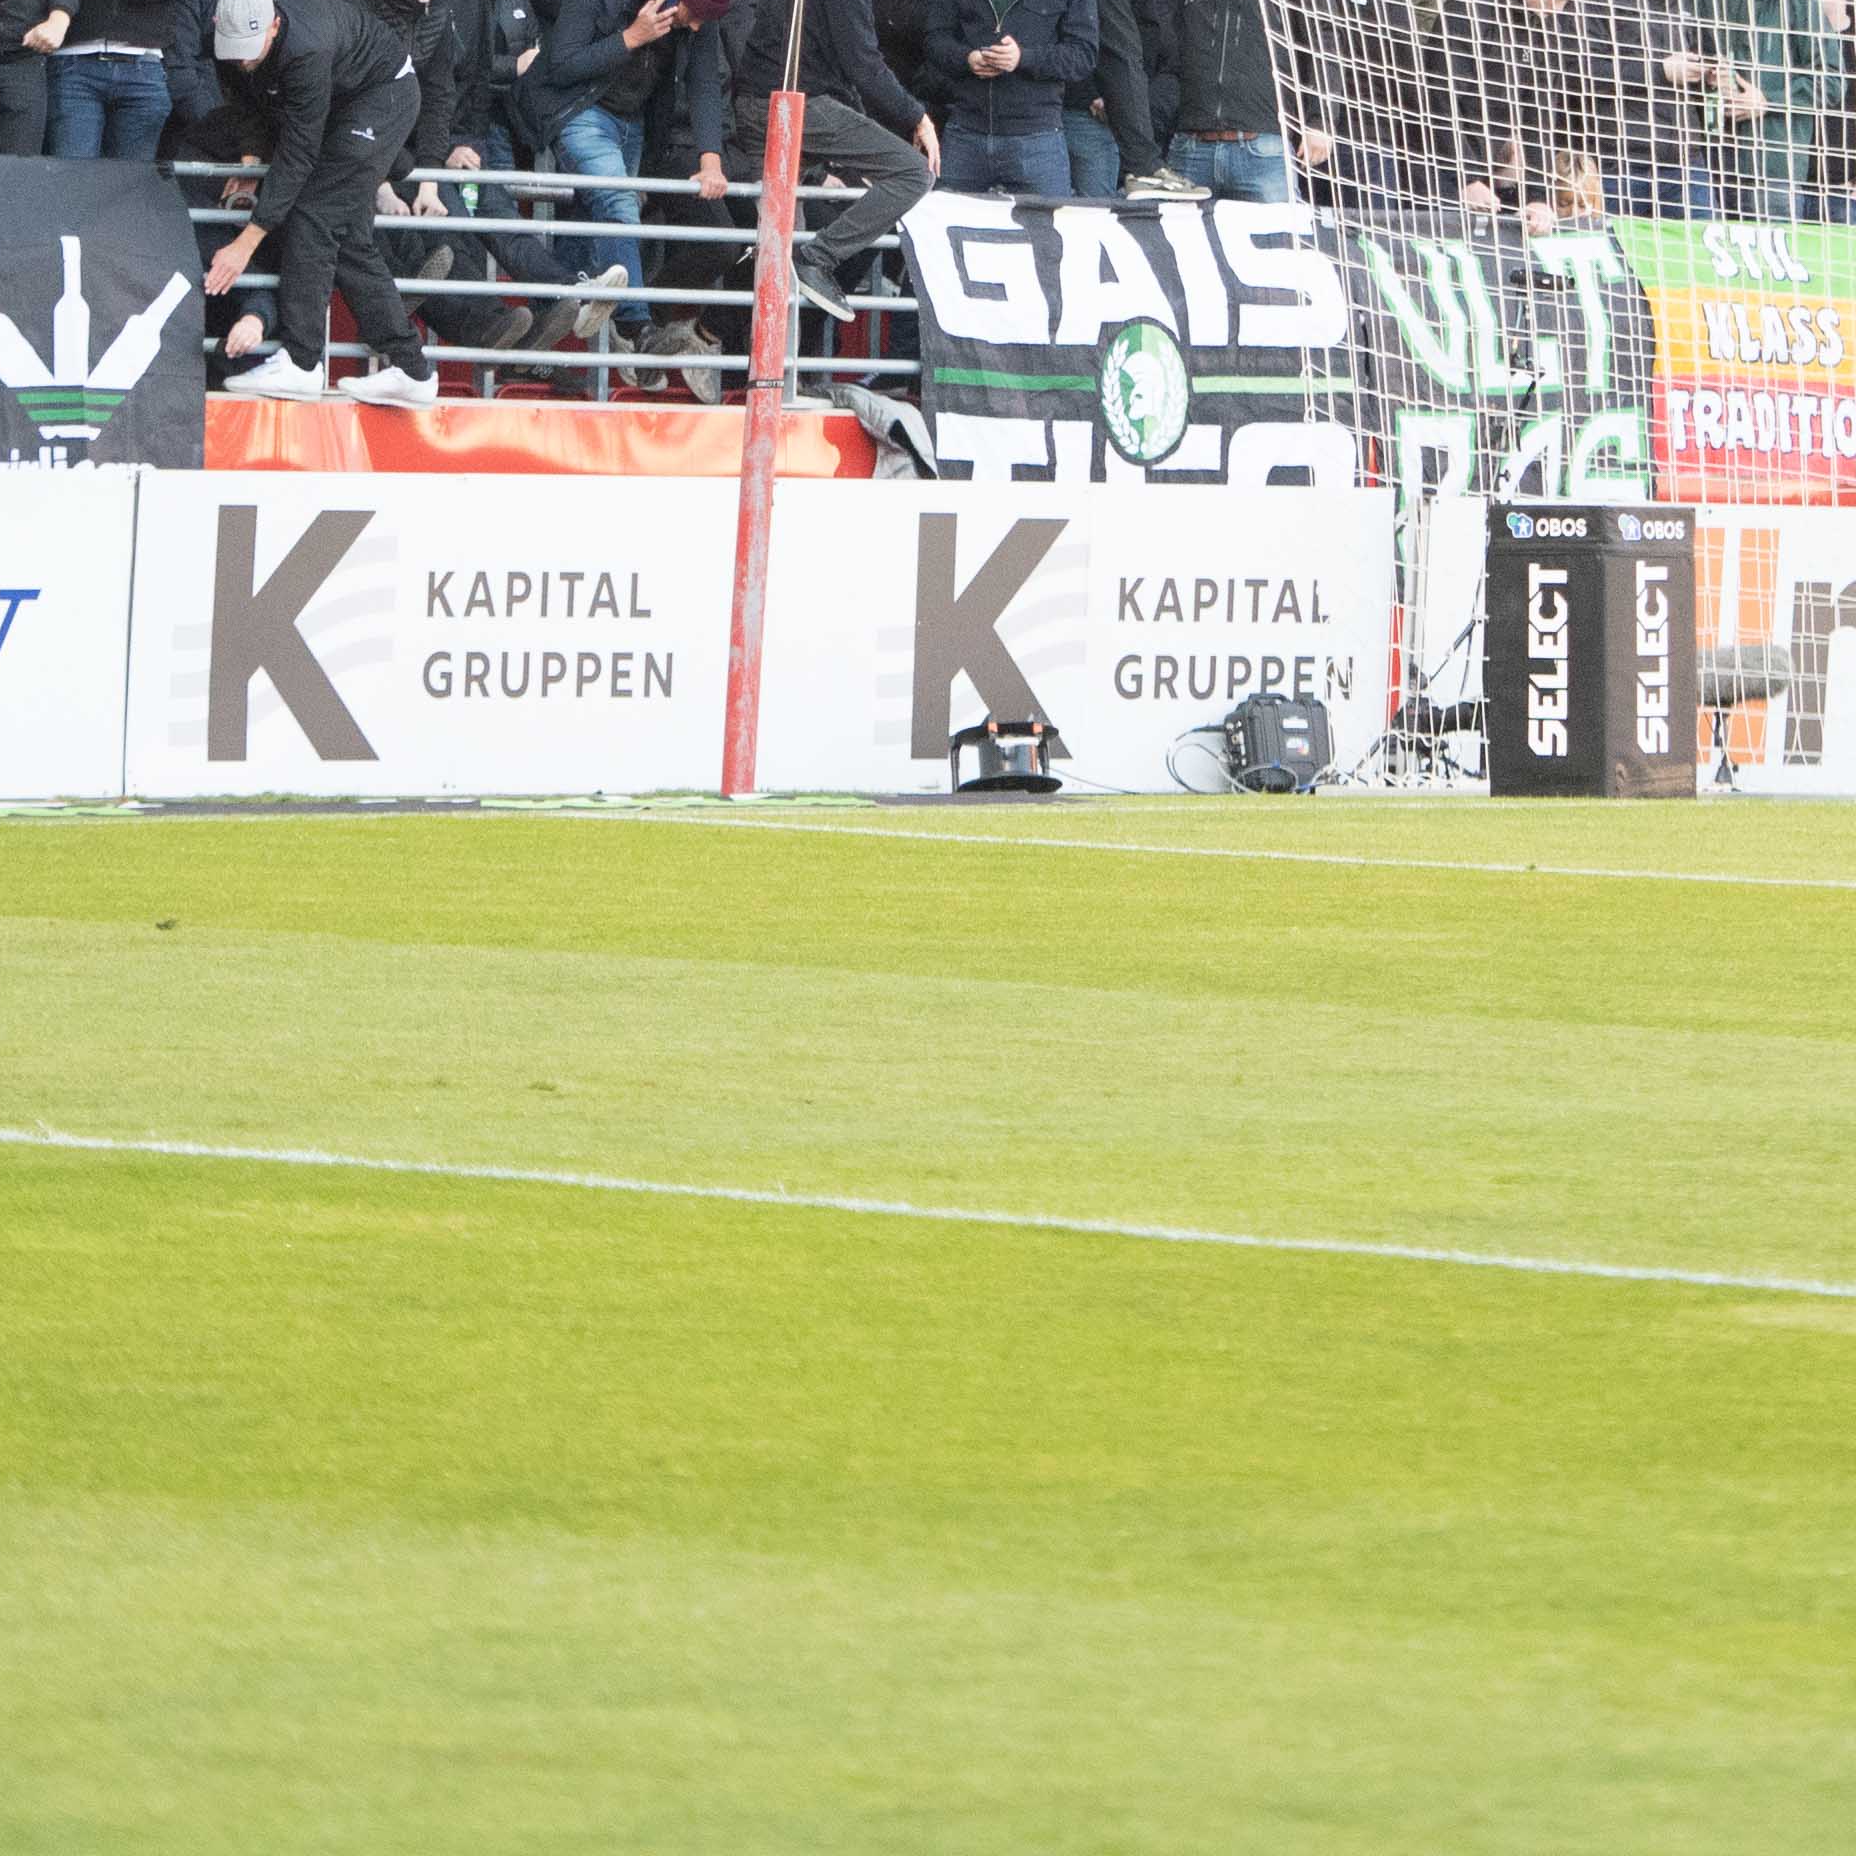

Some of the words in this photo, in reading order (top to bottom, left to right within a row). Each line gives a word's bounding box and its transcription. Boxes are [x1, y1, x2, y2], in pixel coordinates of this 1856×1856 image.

[901, 192, 1346, 348] GAIS
[1703, 224, 1809, 281] STIL
[1703, 302, 1843, 366] KLASS
[1537, 518, 1587, 537] OBOS
[1643, 521, 1685, 540] OBOS
[427, 571, 651, 618] KAPITAL
[1119, 577, 1330, 623] KAPITAL
[423, 651, 673, 697] GRUPPEN
[1114, 654, 1353, 700] GRUPPEN
[1529, 563, 1567, 756] SELECT
[1636, 560, 1668, 753] SELECT
